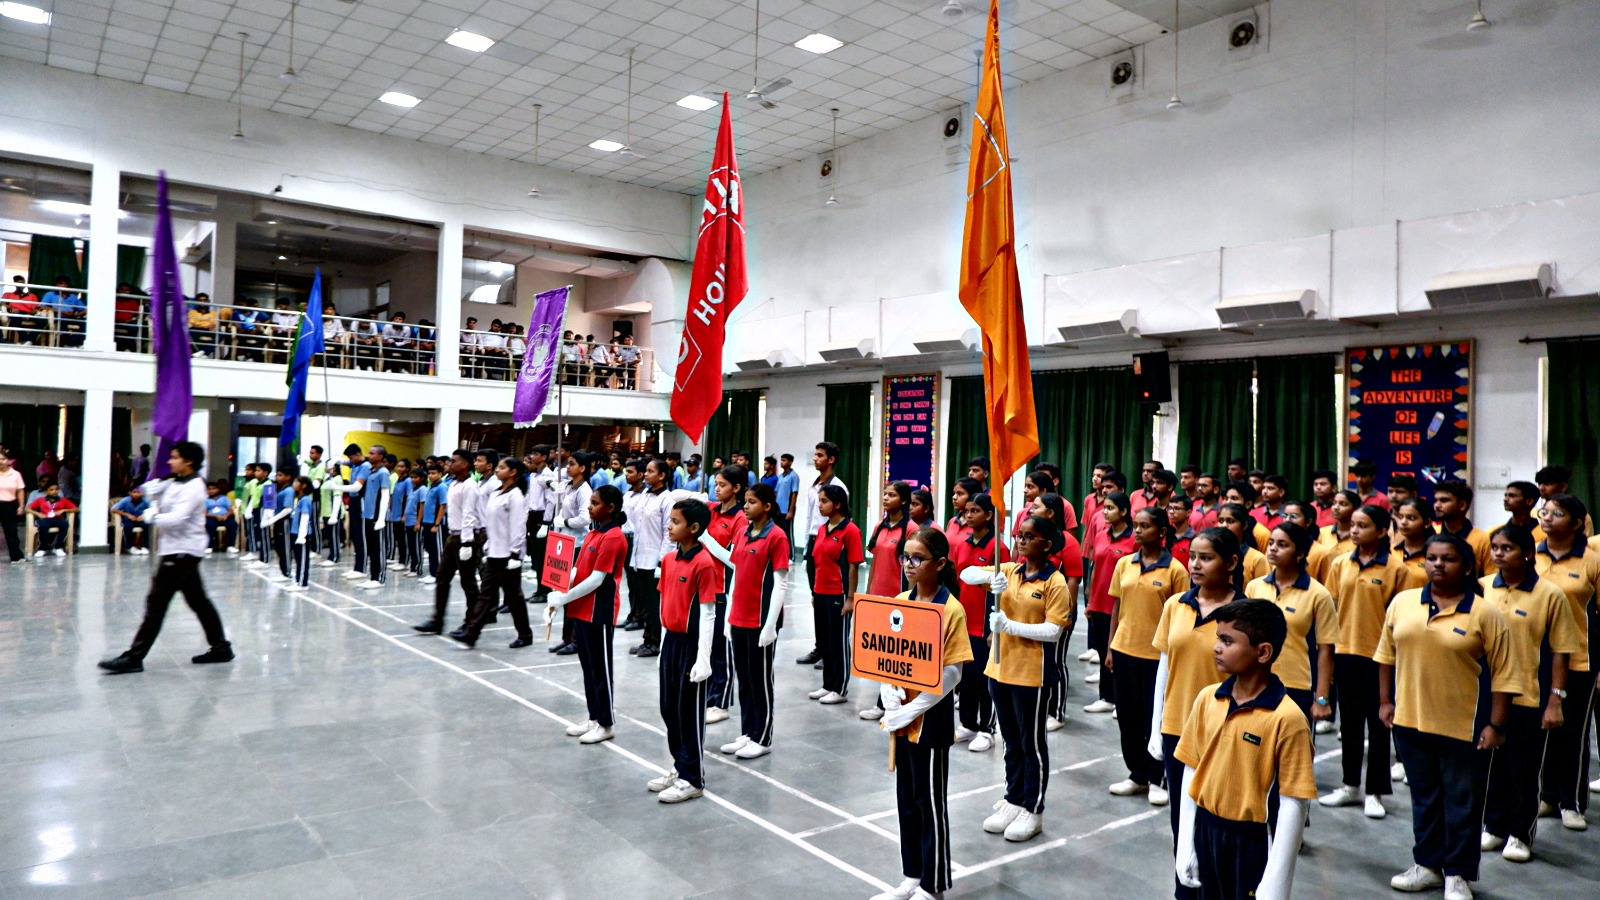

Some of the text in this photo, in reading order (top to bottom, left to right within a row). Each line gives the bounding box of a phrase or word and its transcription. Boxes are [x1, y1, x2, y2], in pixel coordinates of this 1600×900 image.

[1393, 370, 1420, 382] THE
[1365, 391, 1452, 403] ADVENTURE
[1397, 411, 1416, 424] OF
[1391, 431, 1419, 444] LIFE
[1397, 451, 1411, 463] IS
[862, 632, 933, 661] SANDIPANI
[877, 657, 913, 677] HOUSE
